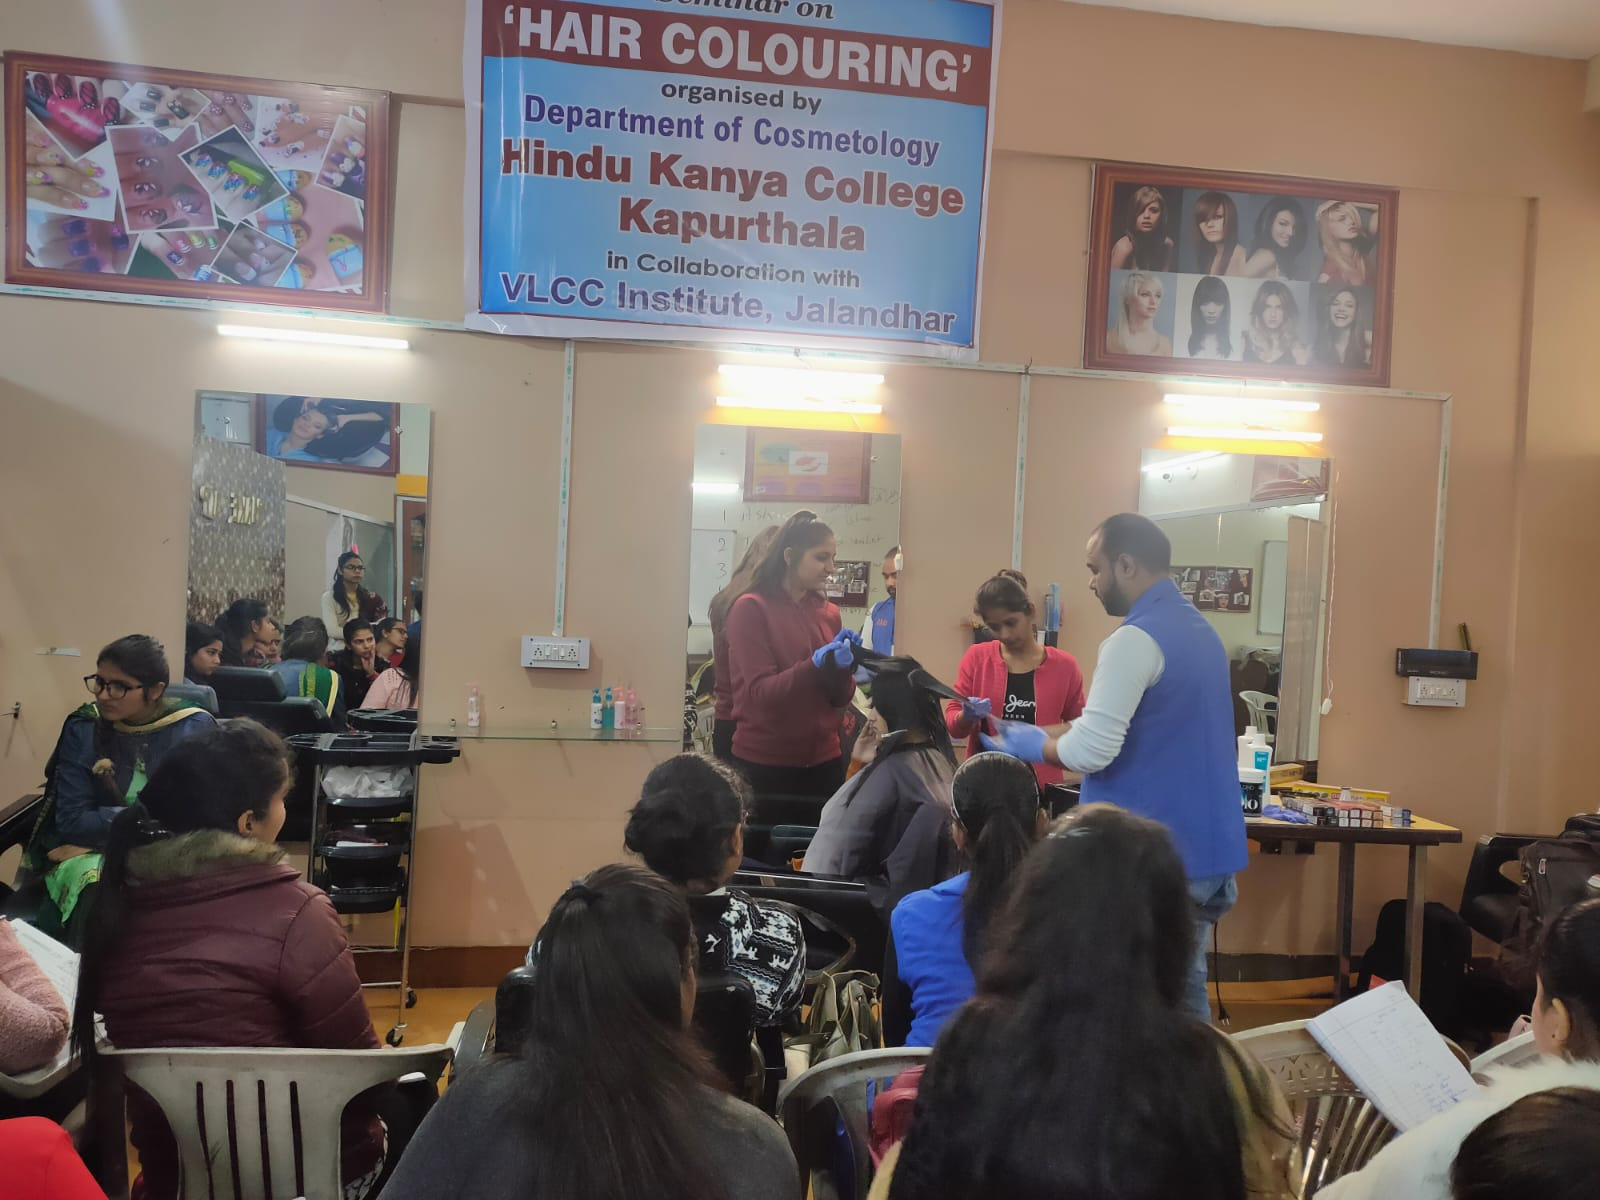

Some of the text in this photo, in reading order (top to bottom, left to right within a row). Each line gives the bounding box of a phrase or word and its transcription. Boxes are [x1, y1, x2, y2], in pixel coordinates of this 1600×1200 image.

[797, 2, 834, 19] on
[661, 83, 822, 115] organised by
[525, 94, 940, 166] Department of Cosmetology
[502, 138, 964, 217] Hindu Kanya College
[620, 197, 865, 251] Kapurthala
[607, 251, 860, 288] in Collaboration with
[502, 273, 956, 333] VLCC Institute, Jalandhar
